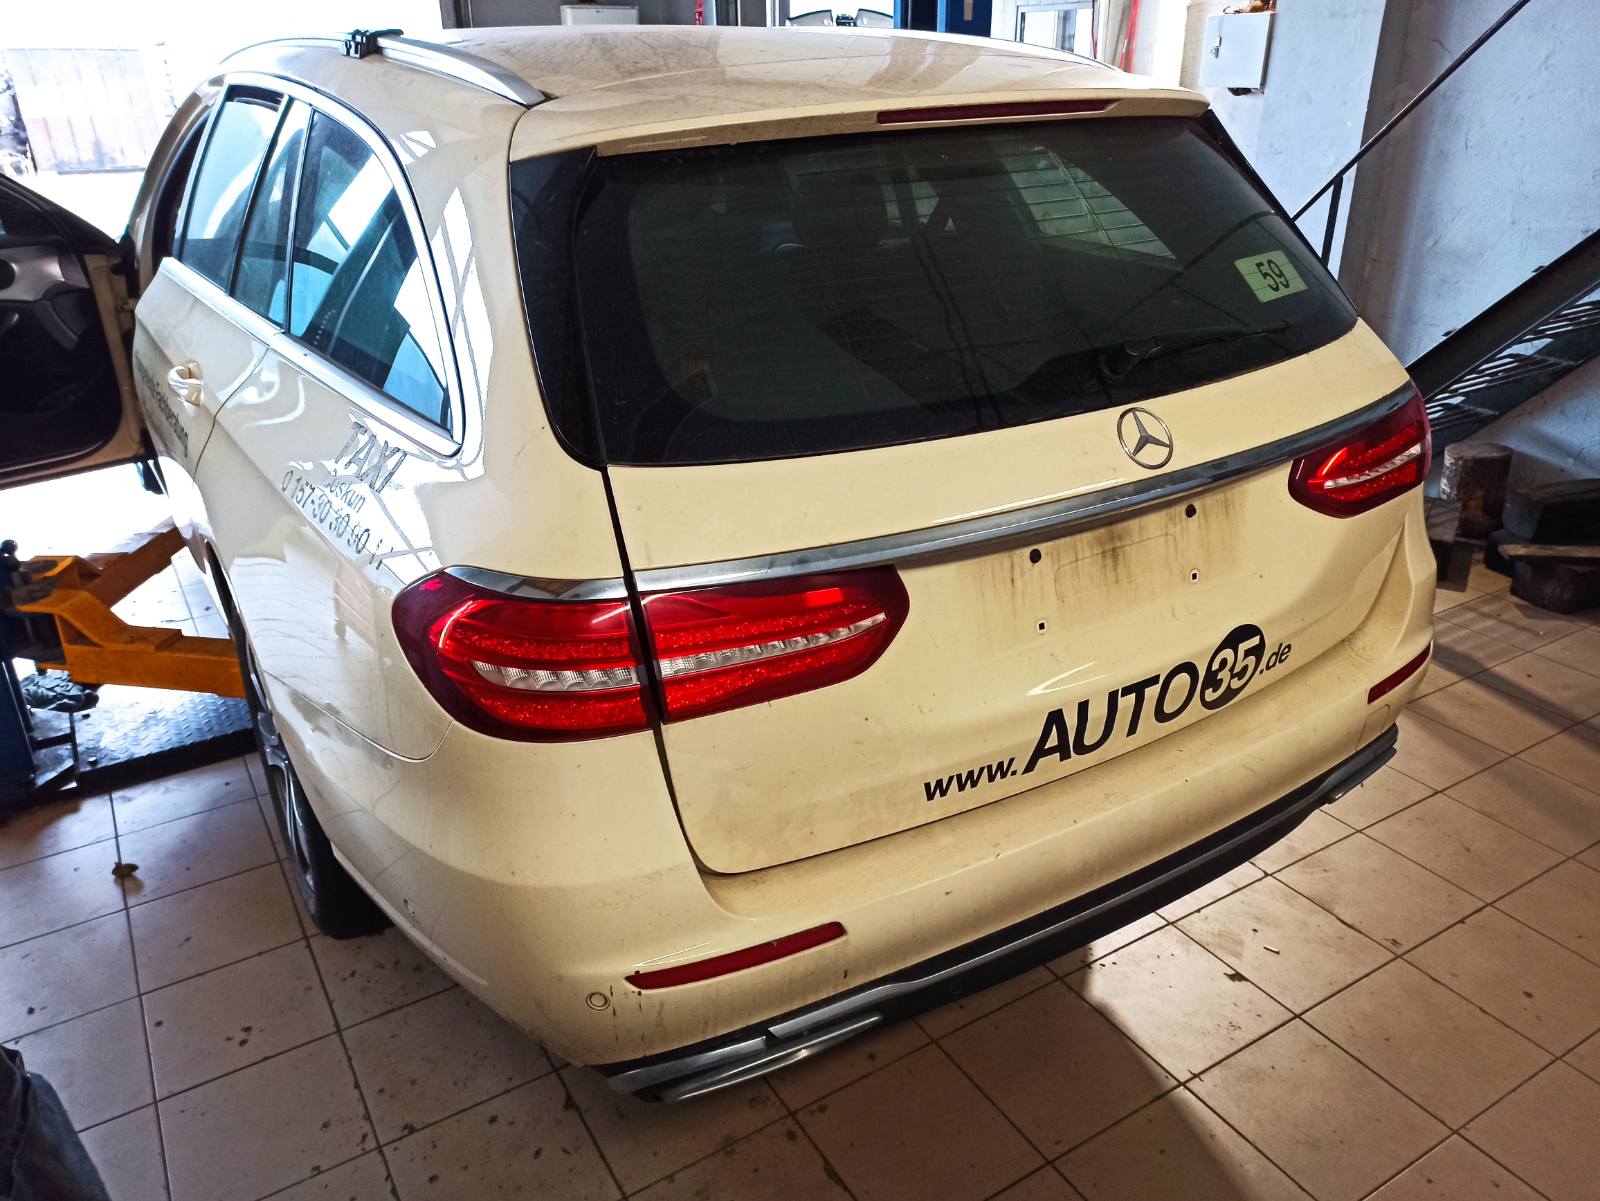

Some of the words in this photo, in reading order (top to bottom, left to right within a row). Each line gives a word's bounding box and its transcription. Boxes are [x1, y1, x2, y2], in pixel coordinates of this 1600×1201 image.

[1256, 259, 1289, 292] 59
[335, 421, 408, 494] TAXI
[923, 632, 1292, 802] www.AUTO35.de
